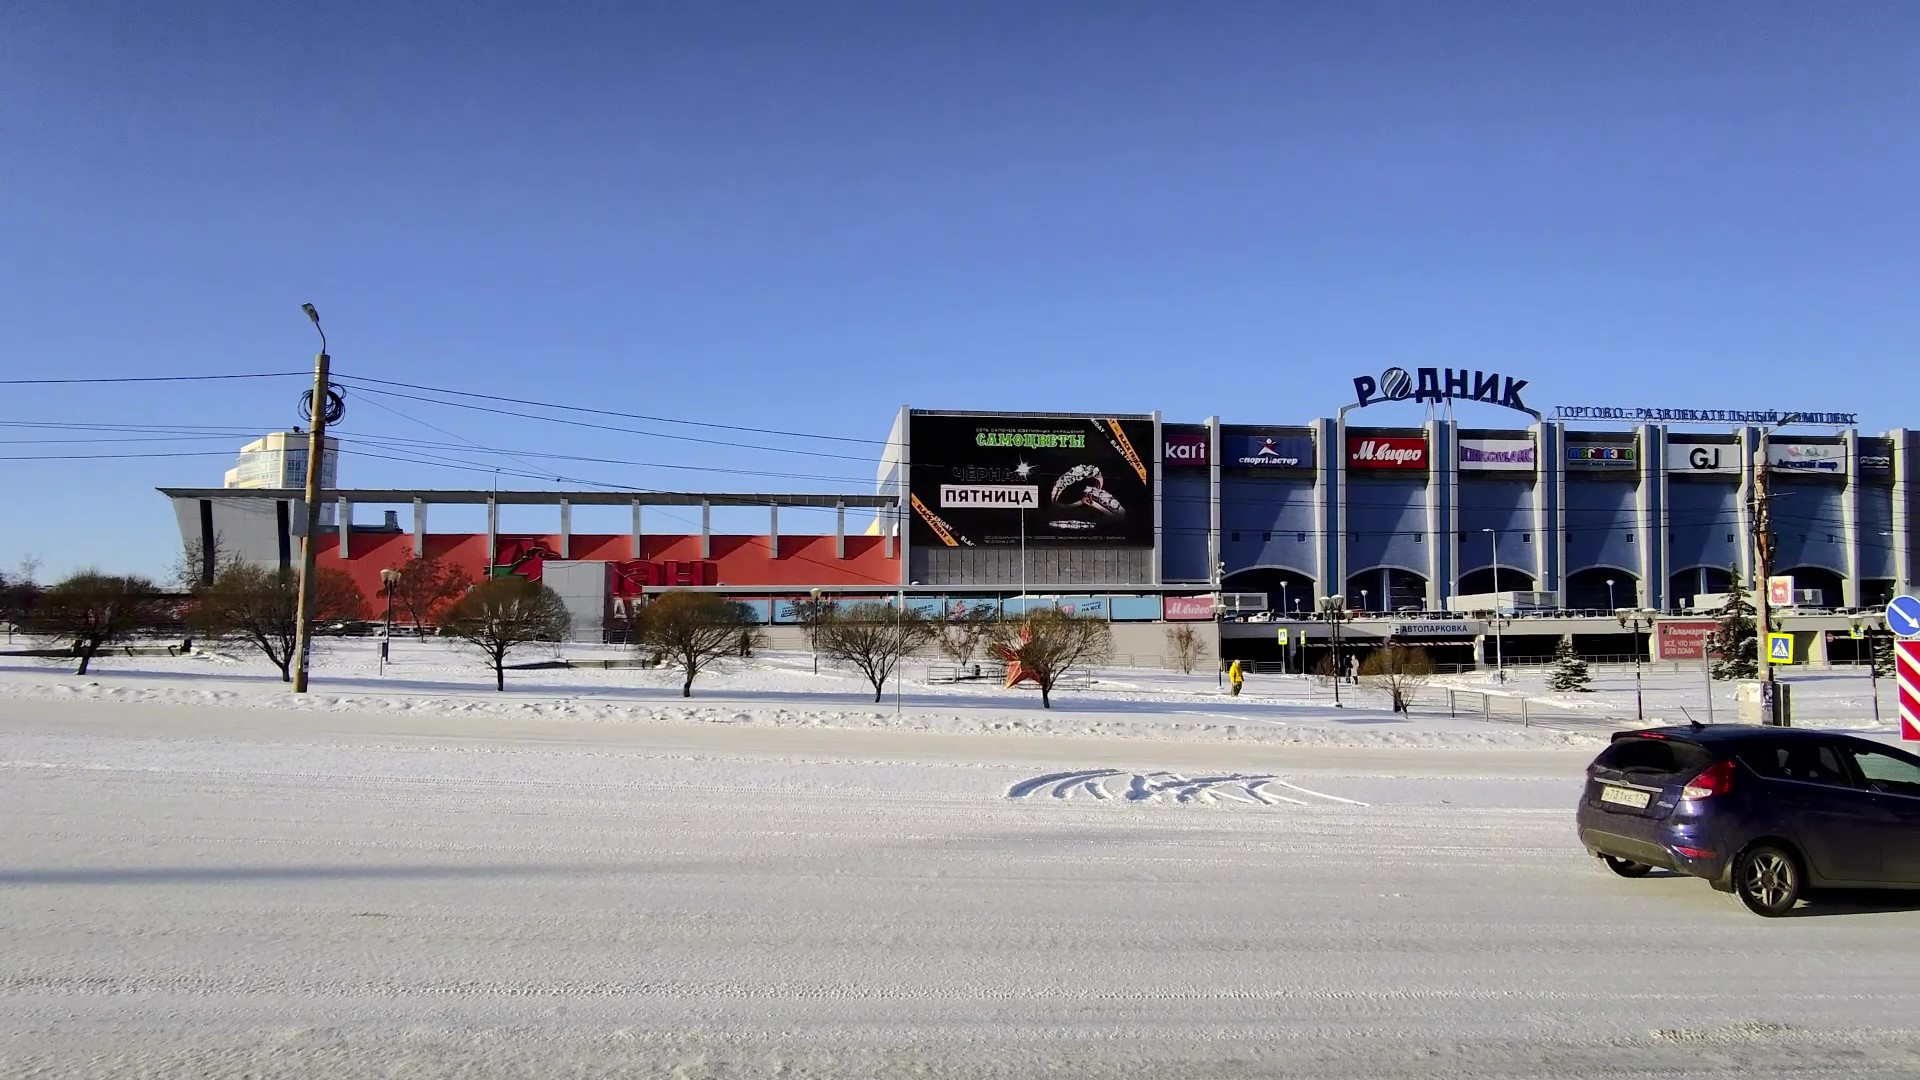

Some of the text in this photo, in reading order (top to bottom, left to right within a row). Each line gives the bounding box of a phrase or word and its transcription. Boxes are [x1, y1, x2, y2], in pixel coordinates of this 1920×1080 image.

[1353, 367, 1529, 408] РОДНИК
[976, 432, 1085, 449] САМОЦВЕТЫ
[1165, 441, 1205, 459] kari
[1352, 440, 1422, 465] М.видео
[1690, 447, 1719, 469] GJ
[945, 489, 1033, 505] ПЯТНИЦА
[1402, 625, 1468, 633] АВТОПАРКОВКА
